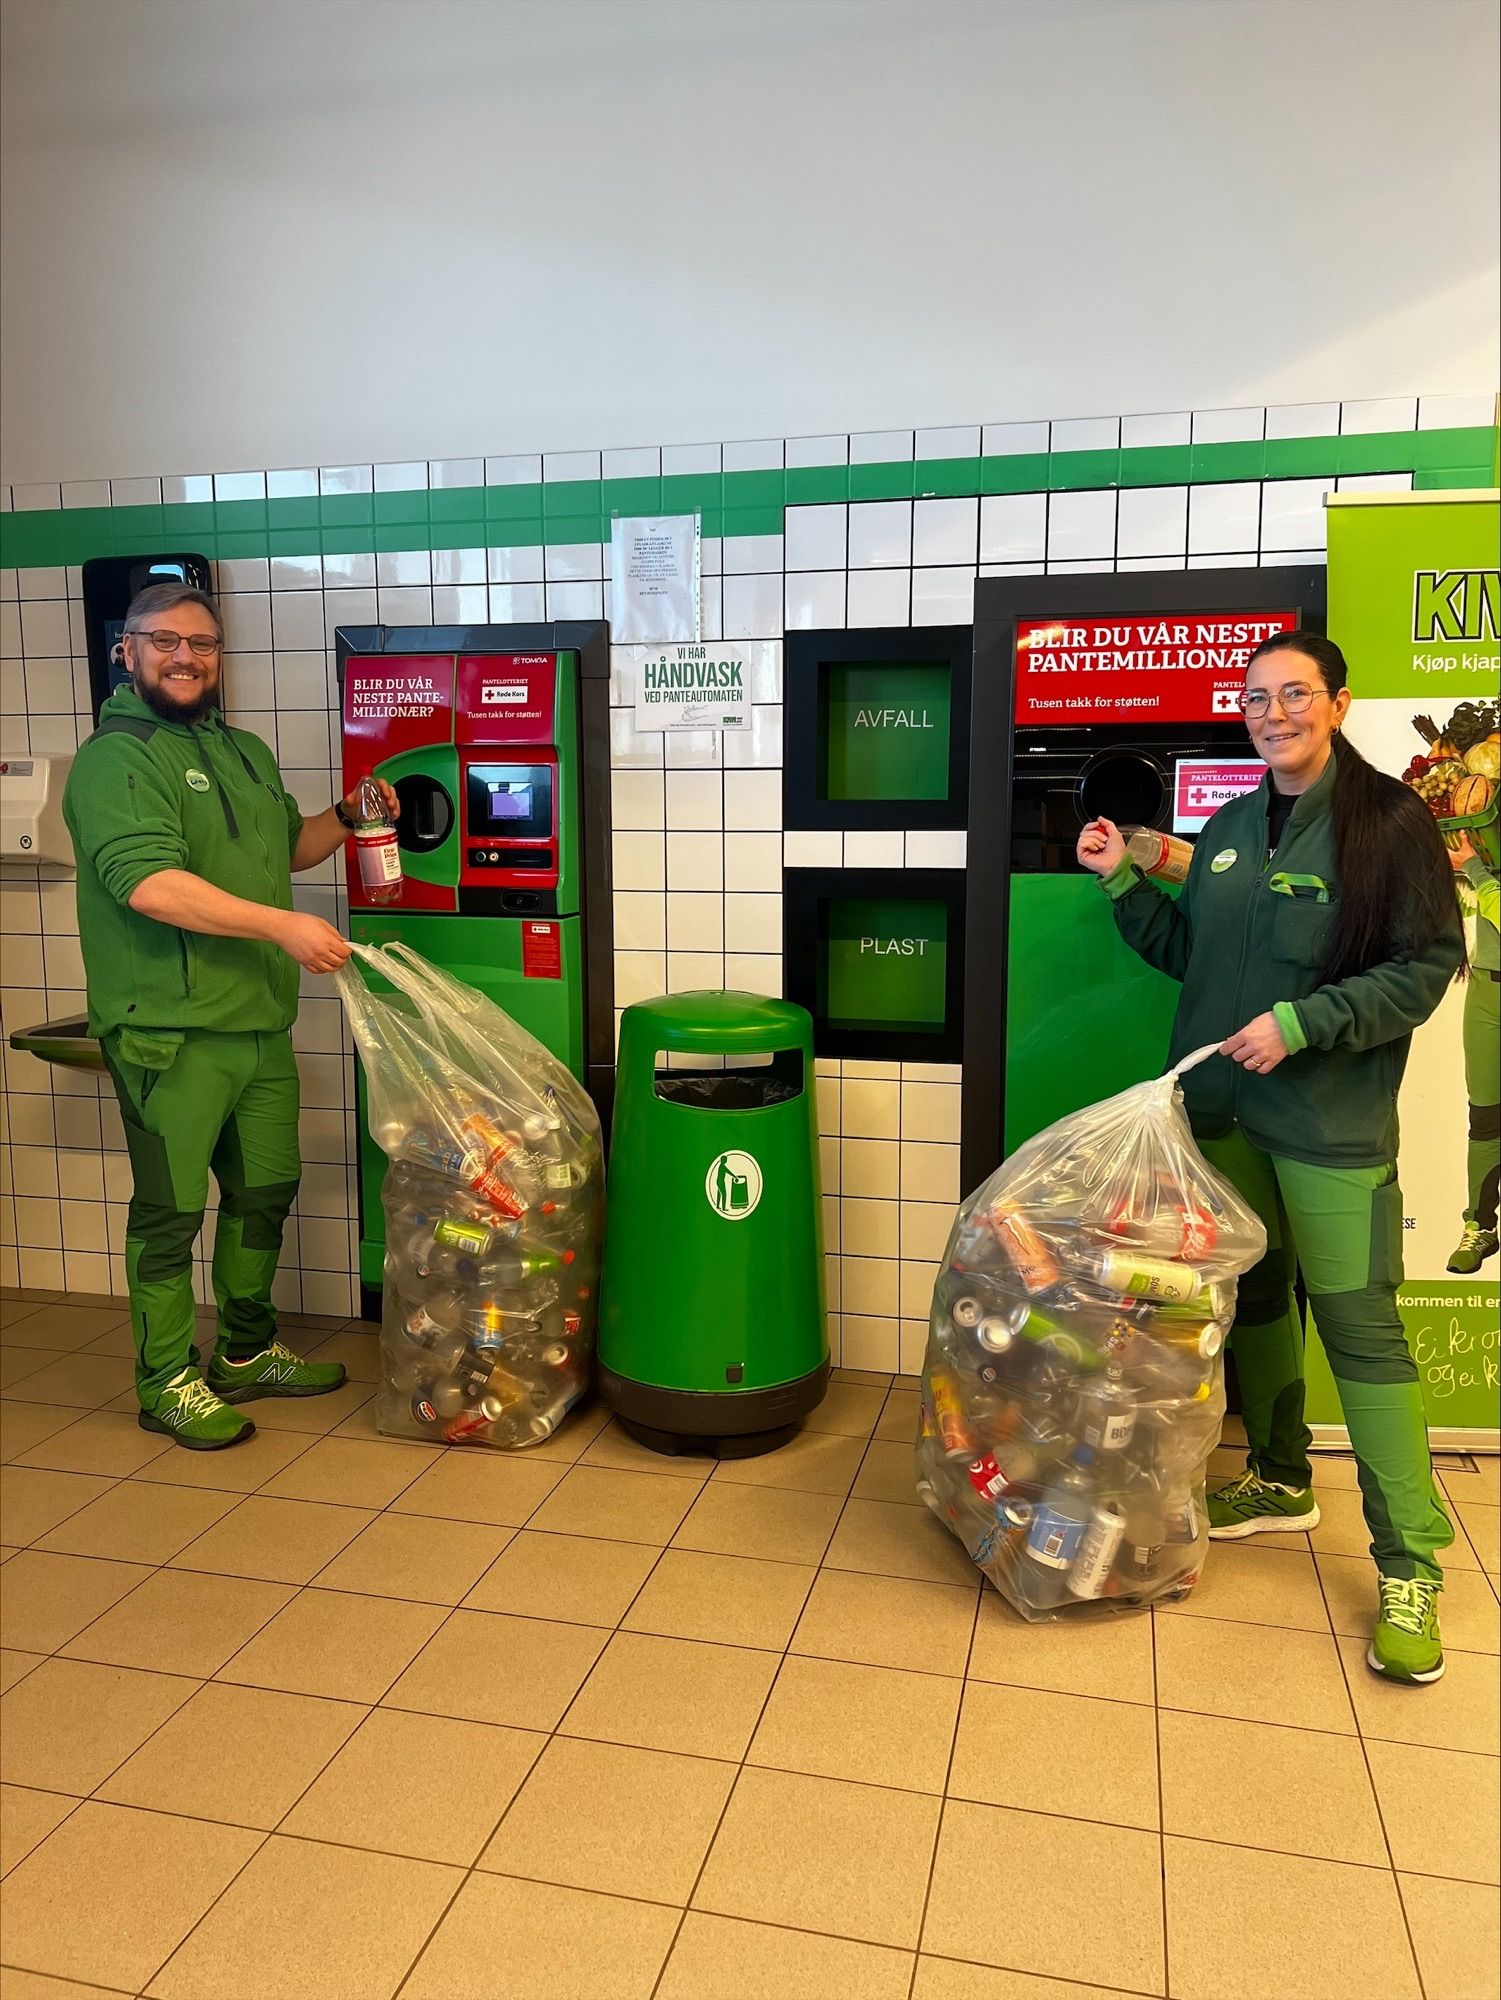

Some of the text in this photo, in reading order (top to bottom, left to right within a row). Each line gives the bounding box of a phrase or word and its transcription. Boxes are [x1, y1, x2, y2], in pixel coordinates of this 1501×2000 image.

[1028, 629, 1088, 649] BLIR
[1093, 627, 1132, 647] DU
[1136, 622, 1190, 647] VÅR
[677, 647, 706, 659] VI HAR
[1028, 648, 1257, 673] PANTEMILLIONÆ
[1412, 654, 1457, 673] Kjøp
[644, 656, 743, 688] HÅNDVASK
[353, 676, 433, 690] BLIR DU VÅR
[352, 692, 444, 704] NESTE PANTE-
[644, 690, 743, 703] VED PANTEAUTOMATEN
[1028, 696, 1160, 708] Tusen takk for støtten!
[352, 706, 434, 718] MILLIONÆR?
[467, 711, 487, 719] Tusen
[488, 711, 504, 719] takk
[854, 710, 934, 728] AVFALL
[1191, 774, 1263, 782] PANTELOTTERIET
[1212, 791, 1237, 799] Røde
[860, 937, 929, 956] PLAST
[1396, 1294, 1464, 1308] kommen
[1467, 1295, 1483, 1308] til
